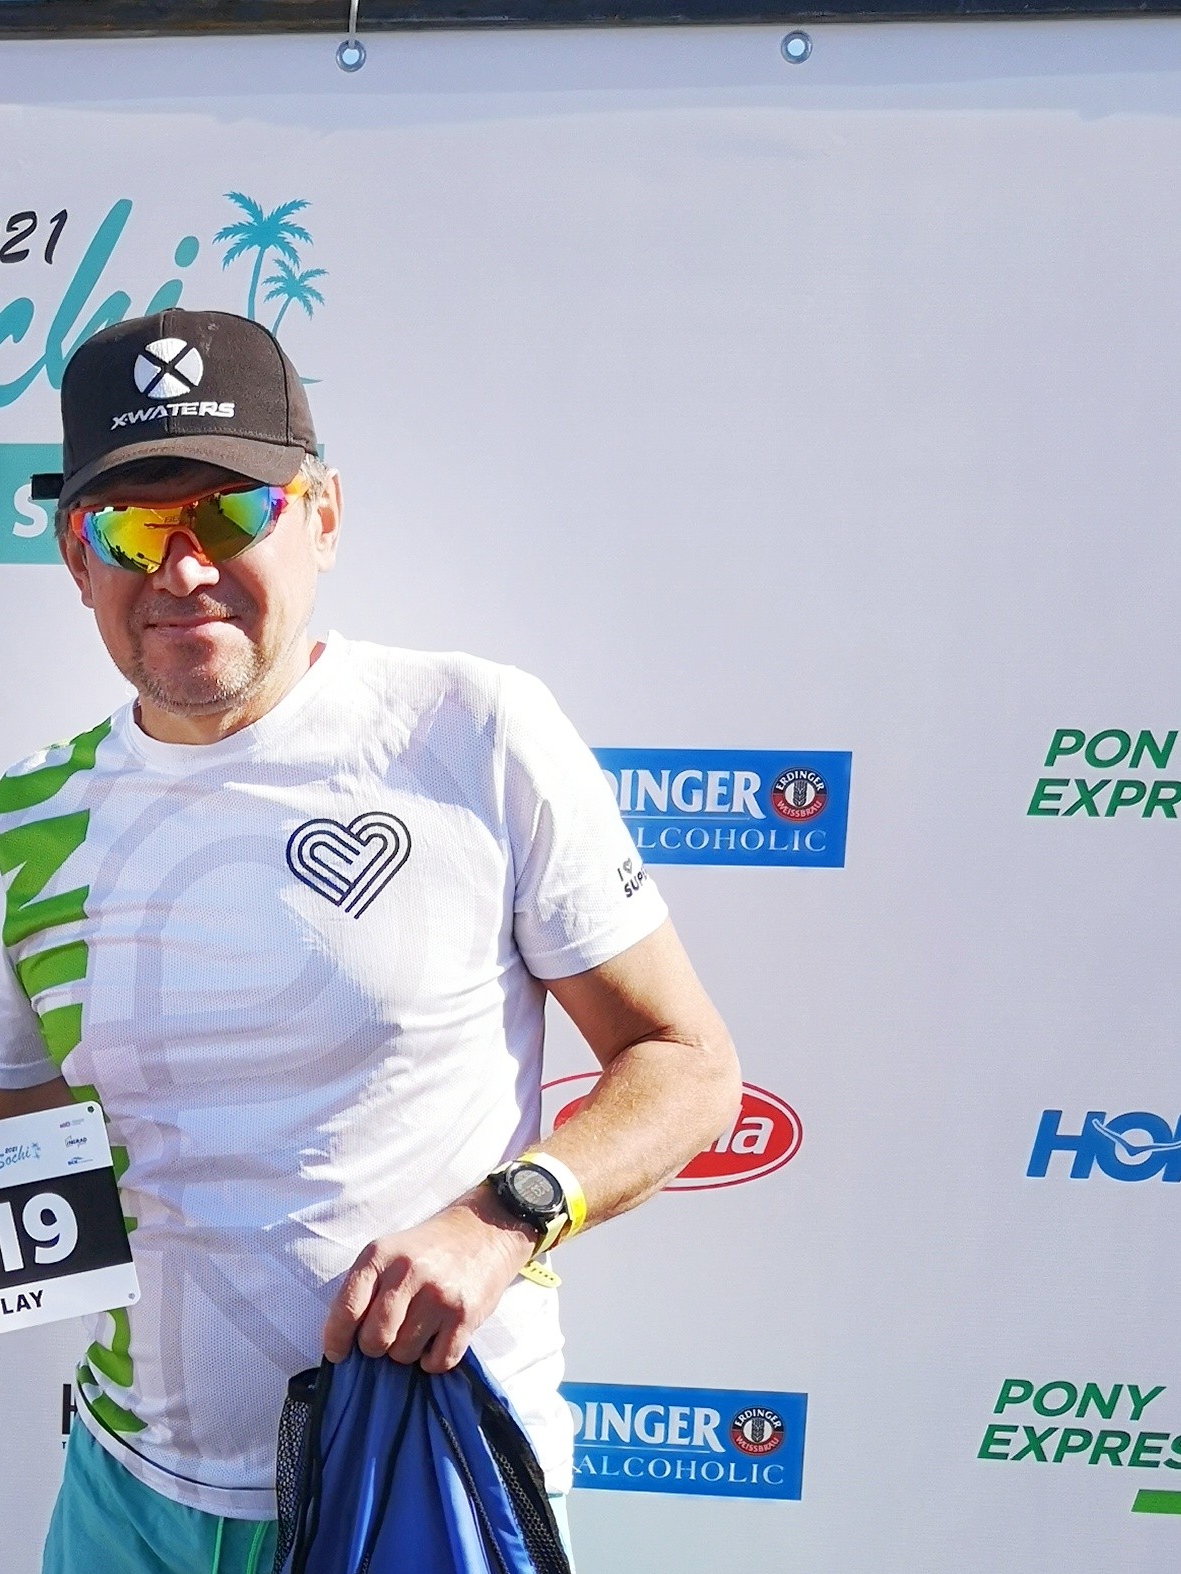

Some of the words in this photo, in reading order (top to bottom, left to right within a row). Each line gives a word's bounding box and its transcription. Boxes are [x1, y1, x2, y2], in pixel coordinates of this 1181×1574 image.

[1044, 728, 1179, 769] PON
[775, 770, 825, 791] ERDINGER
[1026, 778, 1181, 819] EXPR
[636, 827, 826, 852] LCOHOLIC
[1026, 1109, 1181, 1182] HO
[734, 1408, 782, 1429] ERDINGER
[993, 1378, 1167, 1421] PONY
